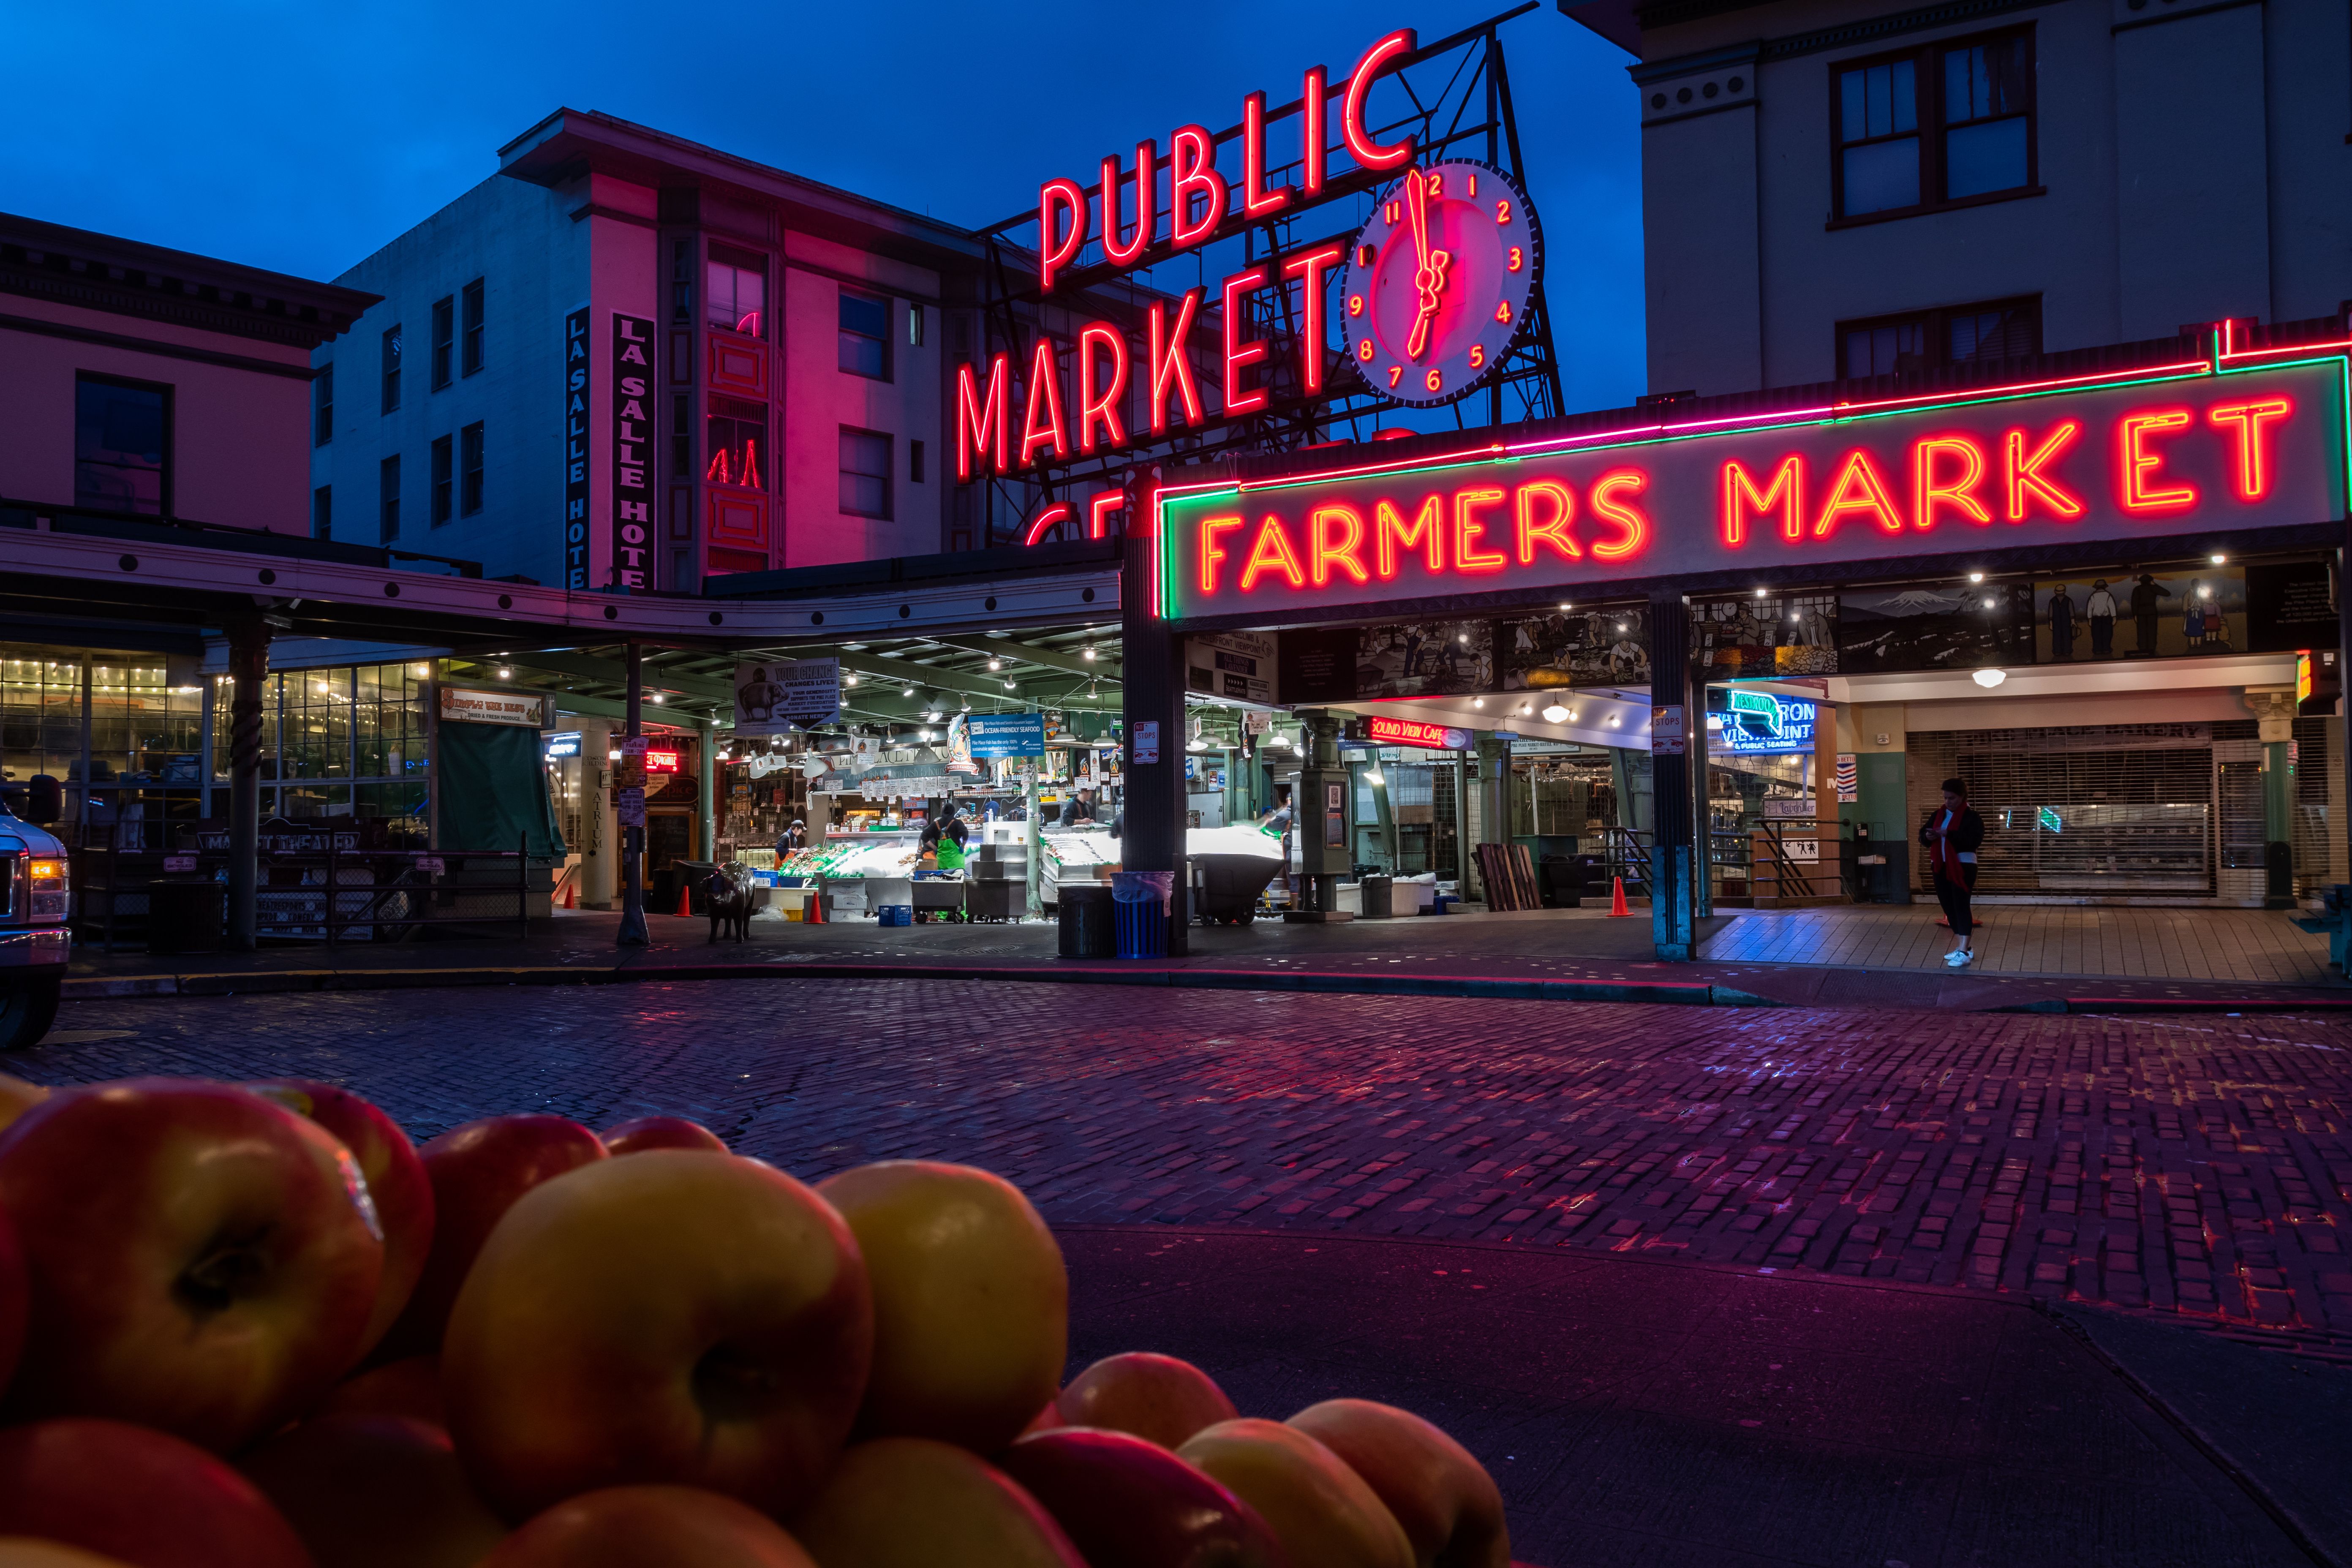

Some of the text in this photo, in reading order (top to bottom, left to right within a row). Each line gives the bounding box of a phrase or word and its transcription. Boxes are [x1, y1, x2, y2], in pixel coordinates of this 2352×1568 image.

[1039, 27, 1417, 294] PUBLIC
[1469, 174, 1477, 197] 1
[1385, 200, 1400, 226] 11
[1496, 200, 1512, 224] 2
[1358, 244, 1377, 267] 10
[1508, 247, 1522, 272] 3
[1349, 295, 1363, 317] 9
[1494, 299, 1513, 324] 4
[956, 240, 1347, 484] MARKET
[1359, 339, 1375, 362] 8
[1469, 344, 1484, 368] 5
[1388, 365, 1403, 389] 7
[1426, 369, 1442, 392] 6
[569, 369, 585, 484] SALLE
[621, 377, 646, 488] SALLE
[1200, 473, 1646, 591] FARMERS
[1725, 400, 2289, 545] MARKET
[1235, 640, 1261, 654] VIEWPOINT
[775, 664, 837, 681] YOUR CHANGE
[1225, 663, 1248, 674] LAVENDER
[1233, 656, 1249, 666] THINGS
[1373, 719, 1443, 740] SOUND VIEW CAFE
[1656, 717, 1680, 726] STOPS
[1779, 803, 1815, 814] Lavener
[592, 792, 603, 849] ATRIUM
[257, 901, 305, 910] HEATRESPORTS
[257, 912, 315, 921] MPROV COMEDY
